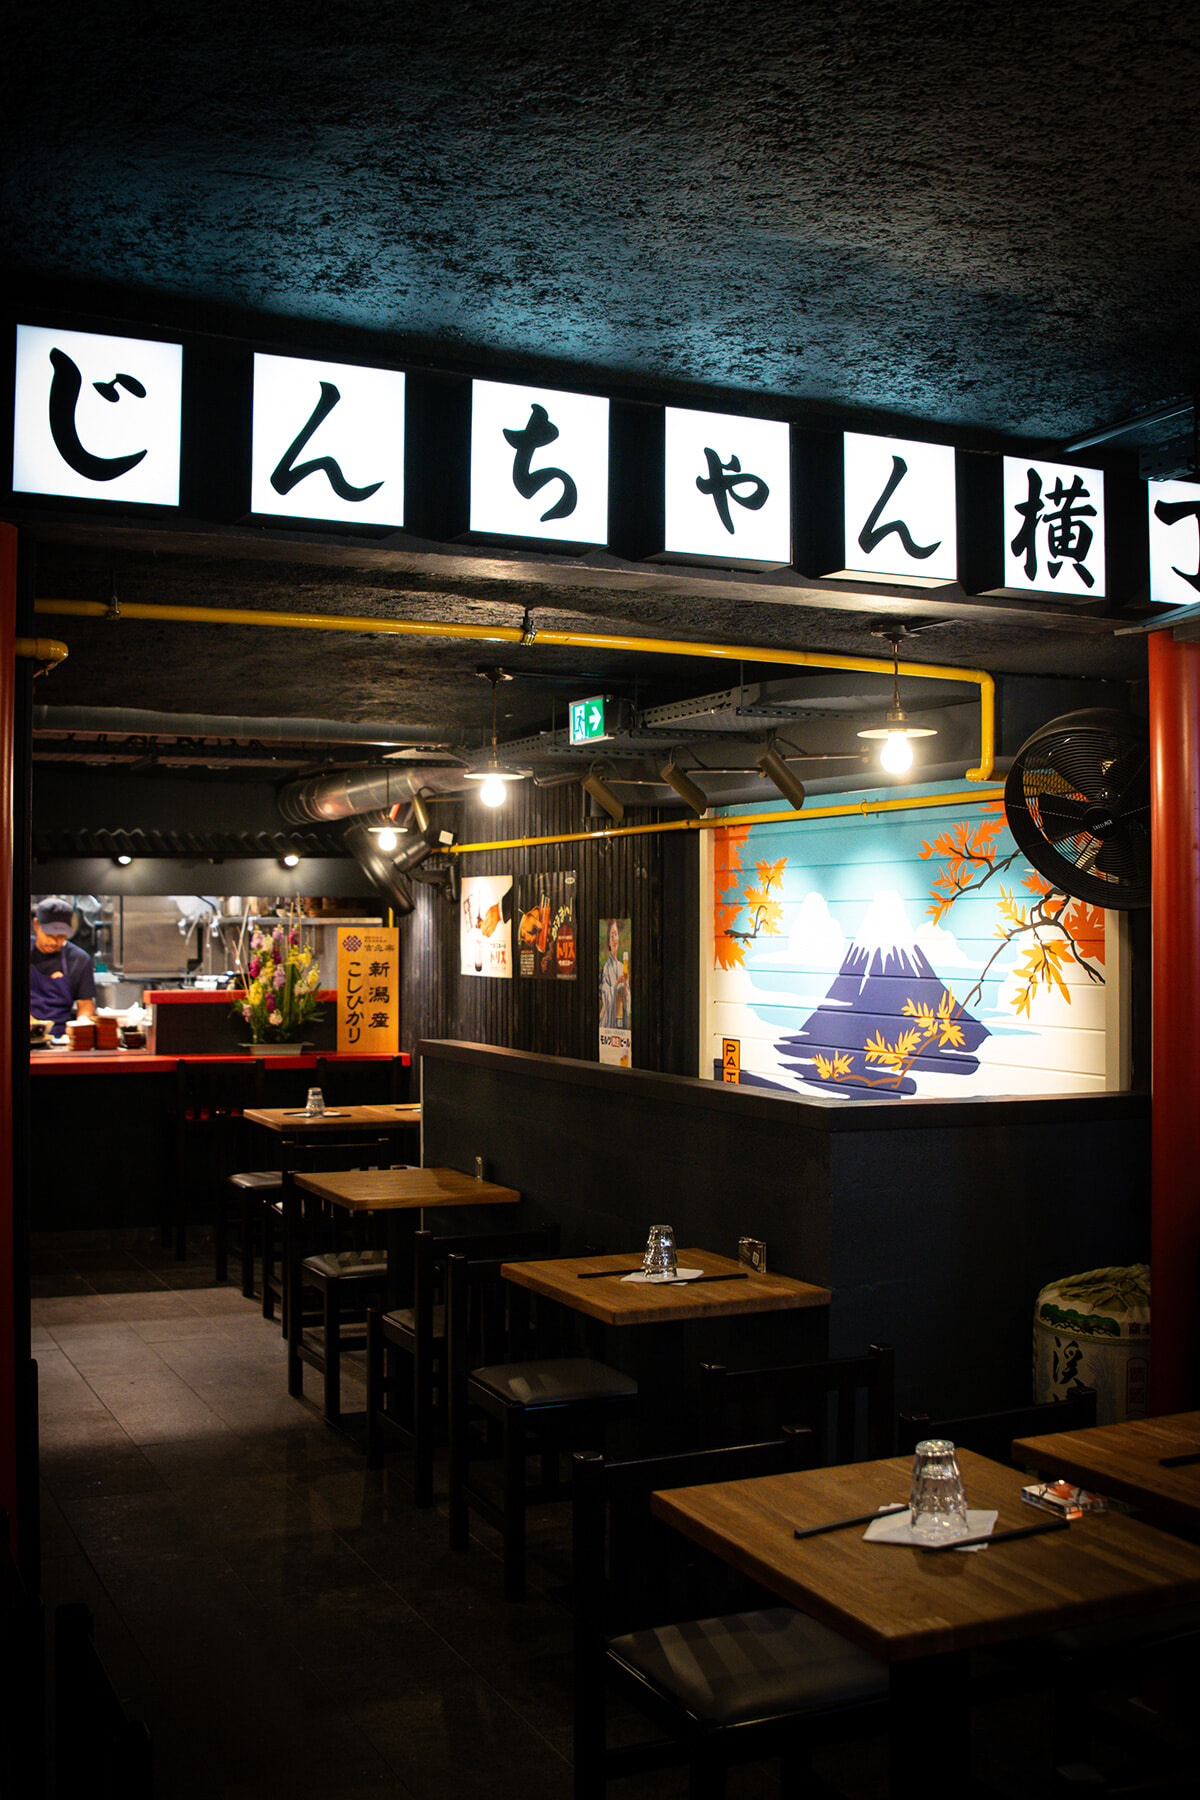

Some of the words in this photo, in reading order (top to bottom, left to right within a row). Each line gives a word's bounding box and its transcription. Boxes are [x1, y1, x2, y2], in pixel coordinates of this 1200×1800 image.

[556, 941, 576, 960] トリス
[345, 962, 365, 1044] こしひかり
[368, 961, 391, 1029] 新潟産
